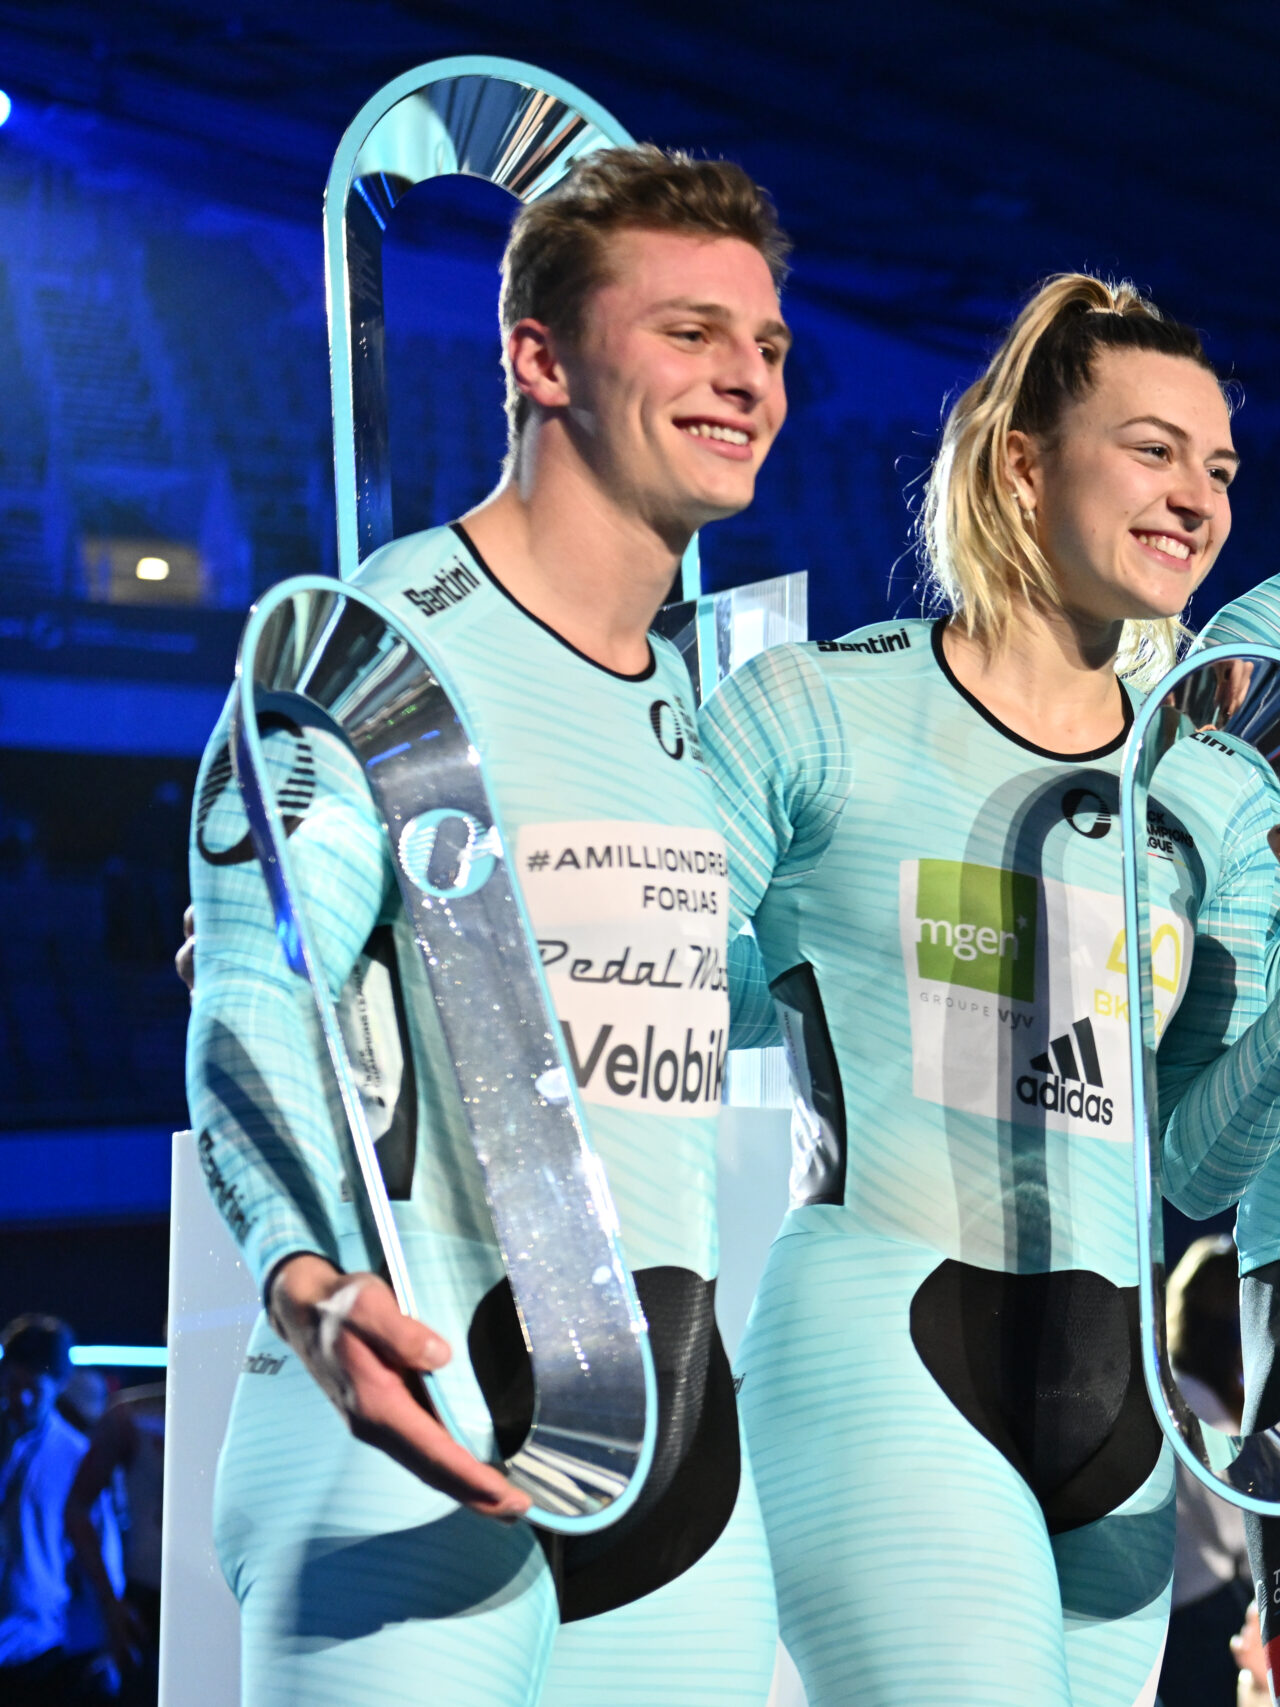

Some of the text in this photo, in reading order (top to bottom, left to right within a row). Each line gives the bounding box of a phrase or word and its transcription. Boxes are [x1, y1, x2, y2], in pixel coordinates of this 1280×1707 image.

[402, 554, 480, 617] Santini
[915, 917, 1019, 961] mgen
[920, 991, 990, 1018] GROUPE
[1016, 1073, 1114, 1126] adidas
